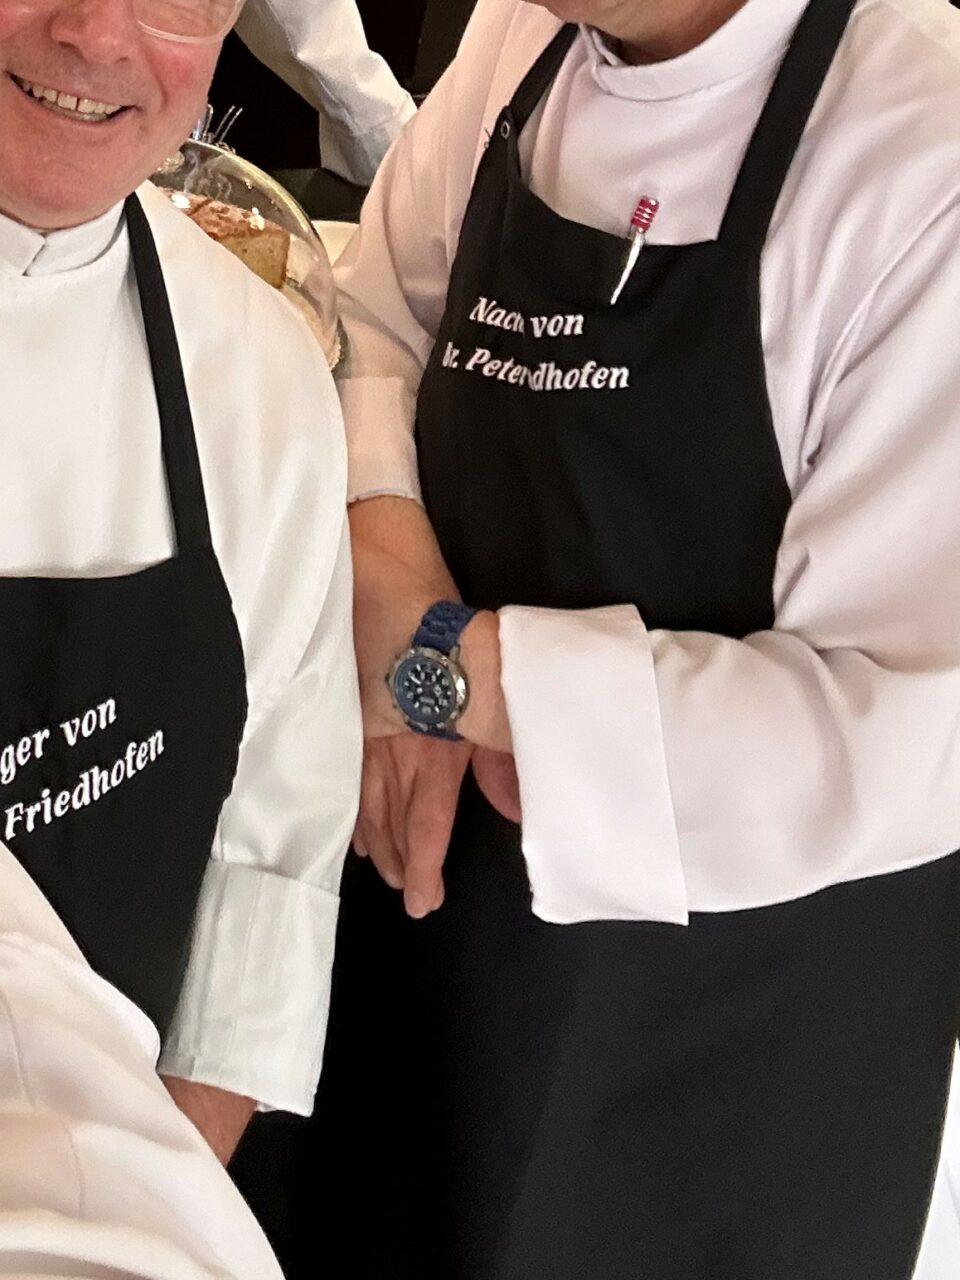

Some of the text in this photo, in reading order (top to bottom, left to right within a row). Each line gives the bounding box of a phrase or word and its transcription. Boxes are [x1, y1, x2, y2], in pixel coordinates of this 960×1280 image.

[530, 313, 584, 338] von
[60, 696, 117, 747] von
[3, 728, 165, 841] Friedhofen
